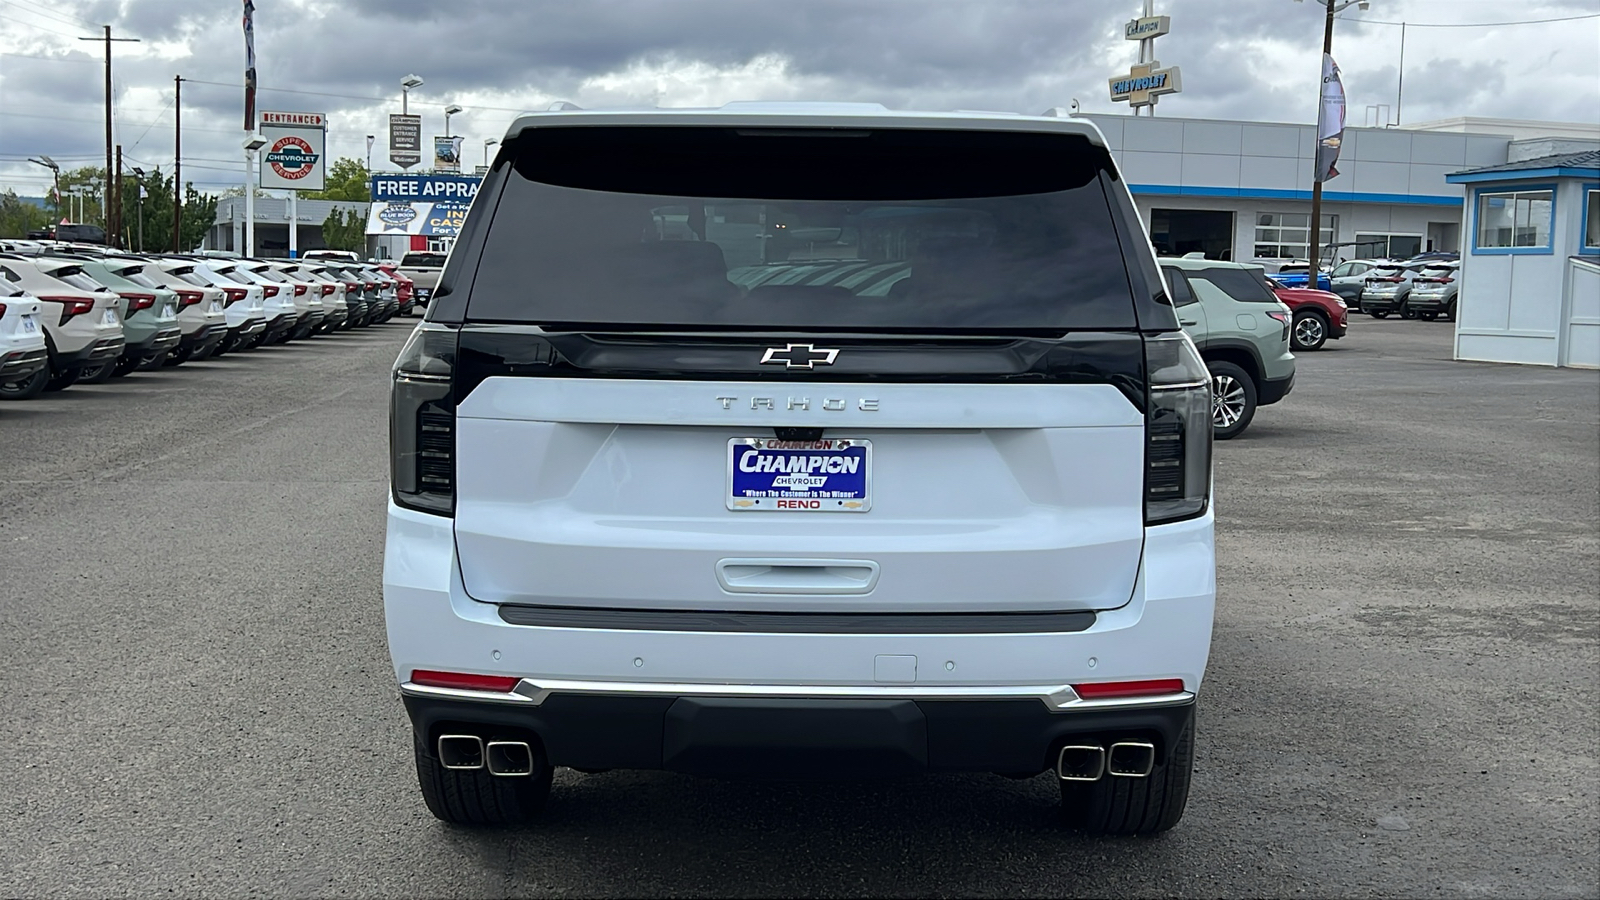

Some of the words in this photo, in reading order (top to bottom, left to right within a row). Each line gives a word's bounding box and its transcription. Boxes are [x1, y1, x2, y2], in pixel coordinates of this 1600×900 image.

[1127, 21, 1159, 36] CHAMPION
[1112, 74, 1167, 94] CHEVROLET
[269, 113, 315, 124] ENTRANCE
[276, 138, 308, 149] SUPER
[268, 154, 315, 162] CHEVROLET
[274, 164, 310, 178] SERVICE
[377, 180, 419, 196] FREE
[716, 396, 880, 412] TAHOE
[766, 439, 833, 450] CHAMPION
[739, 449, 861, 475] CHAMPION
[775, 477, 823, 486] CHEVROLET
[767, 489, 780, 498] The
[780, 489, 811, 498] Customer
[819, 490, 831, 499] The
[777, 500, 821, 510] RENO
